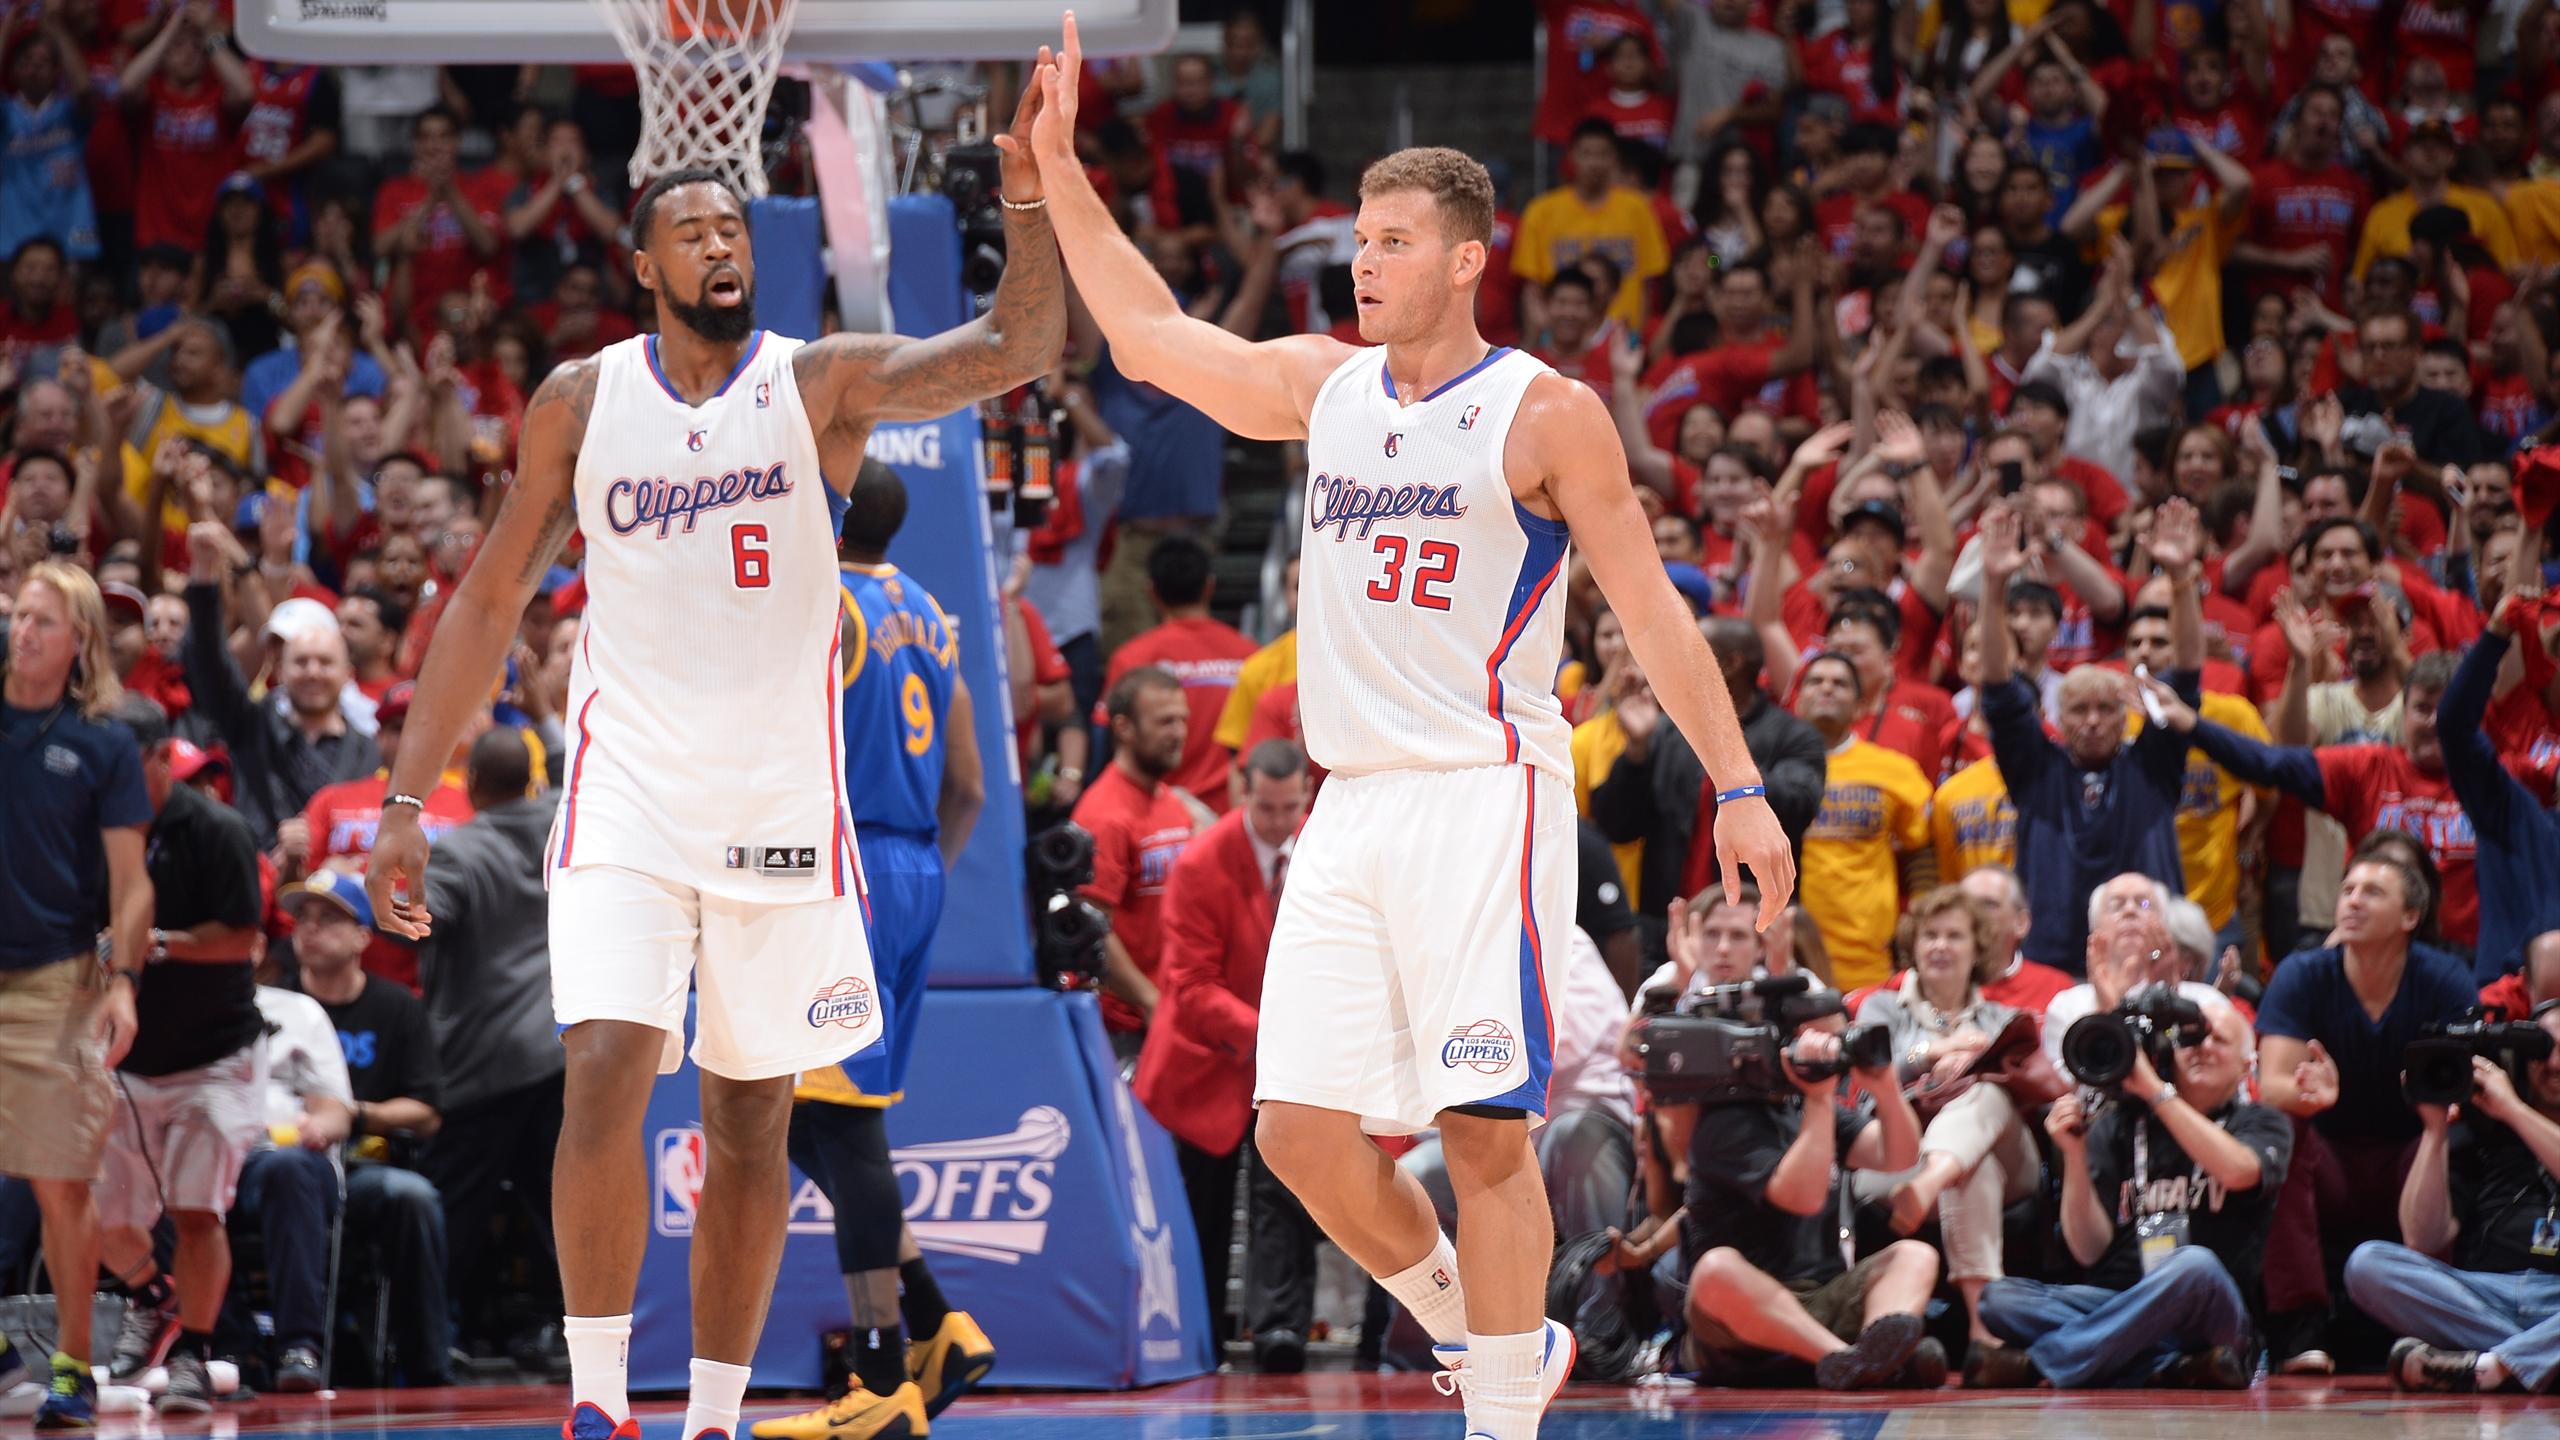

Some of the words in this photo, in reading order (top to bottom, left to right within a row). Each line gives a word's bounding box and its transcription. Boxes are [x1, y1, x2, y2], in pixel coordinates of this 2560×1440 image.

[606, 461, 794, 540] Clippers
[1310, 472, 1468, 542] Clippers
[731, 523, 771, 589] 6
[1366, 534, 1460, 611] 32
[901, 672, 934, 757] 9
[807, 999, 869, 1028] CLIPPERS
[1441, 1037, 1510, 1068] CLIPPERS
